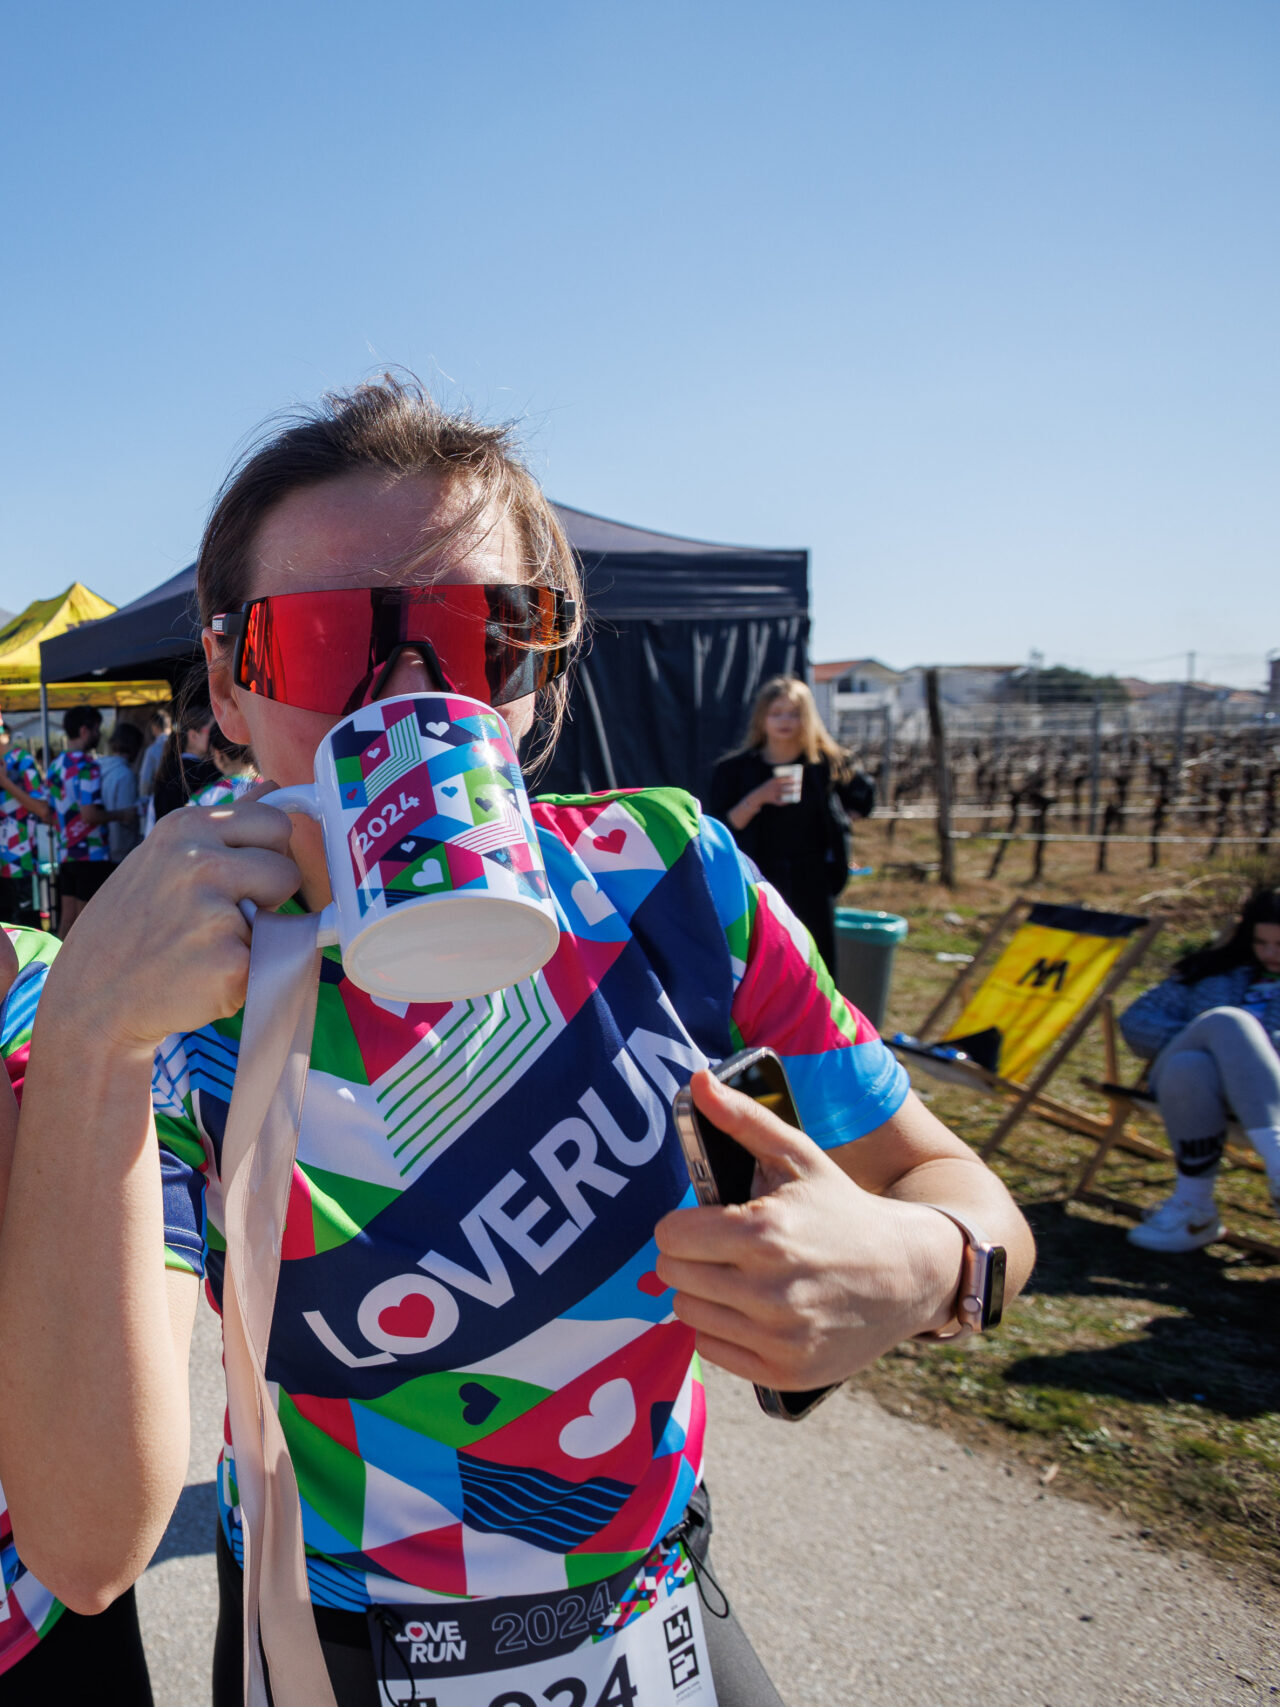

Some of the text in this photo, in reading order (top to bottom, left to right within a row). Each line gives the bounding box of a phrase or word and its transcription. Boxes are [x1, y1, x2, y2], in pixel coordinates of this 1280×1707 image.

[355, 791, 420, 856] 2024
[491, 1580, 616, 1655] 2024
[409, 1639, 468, 1664] RUN
